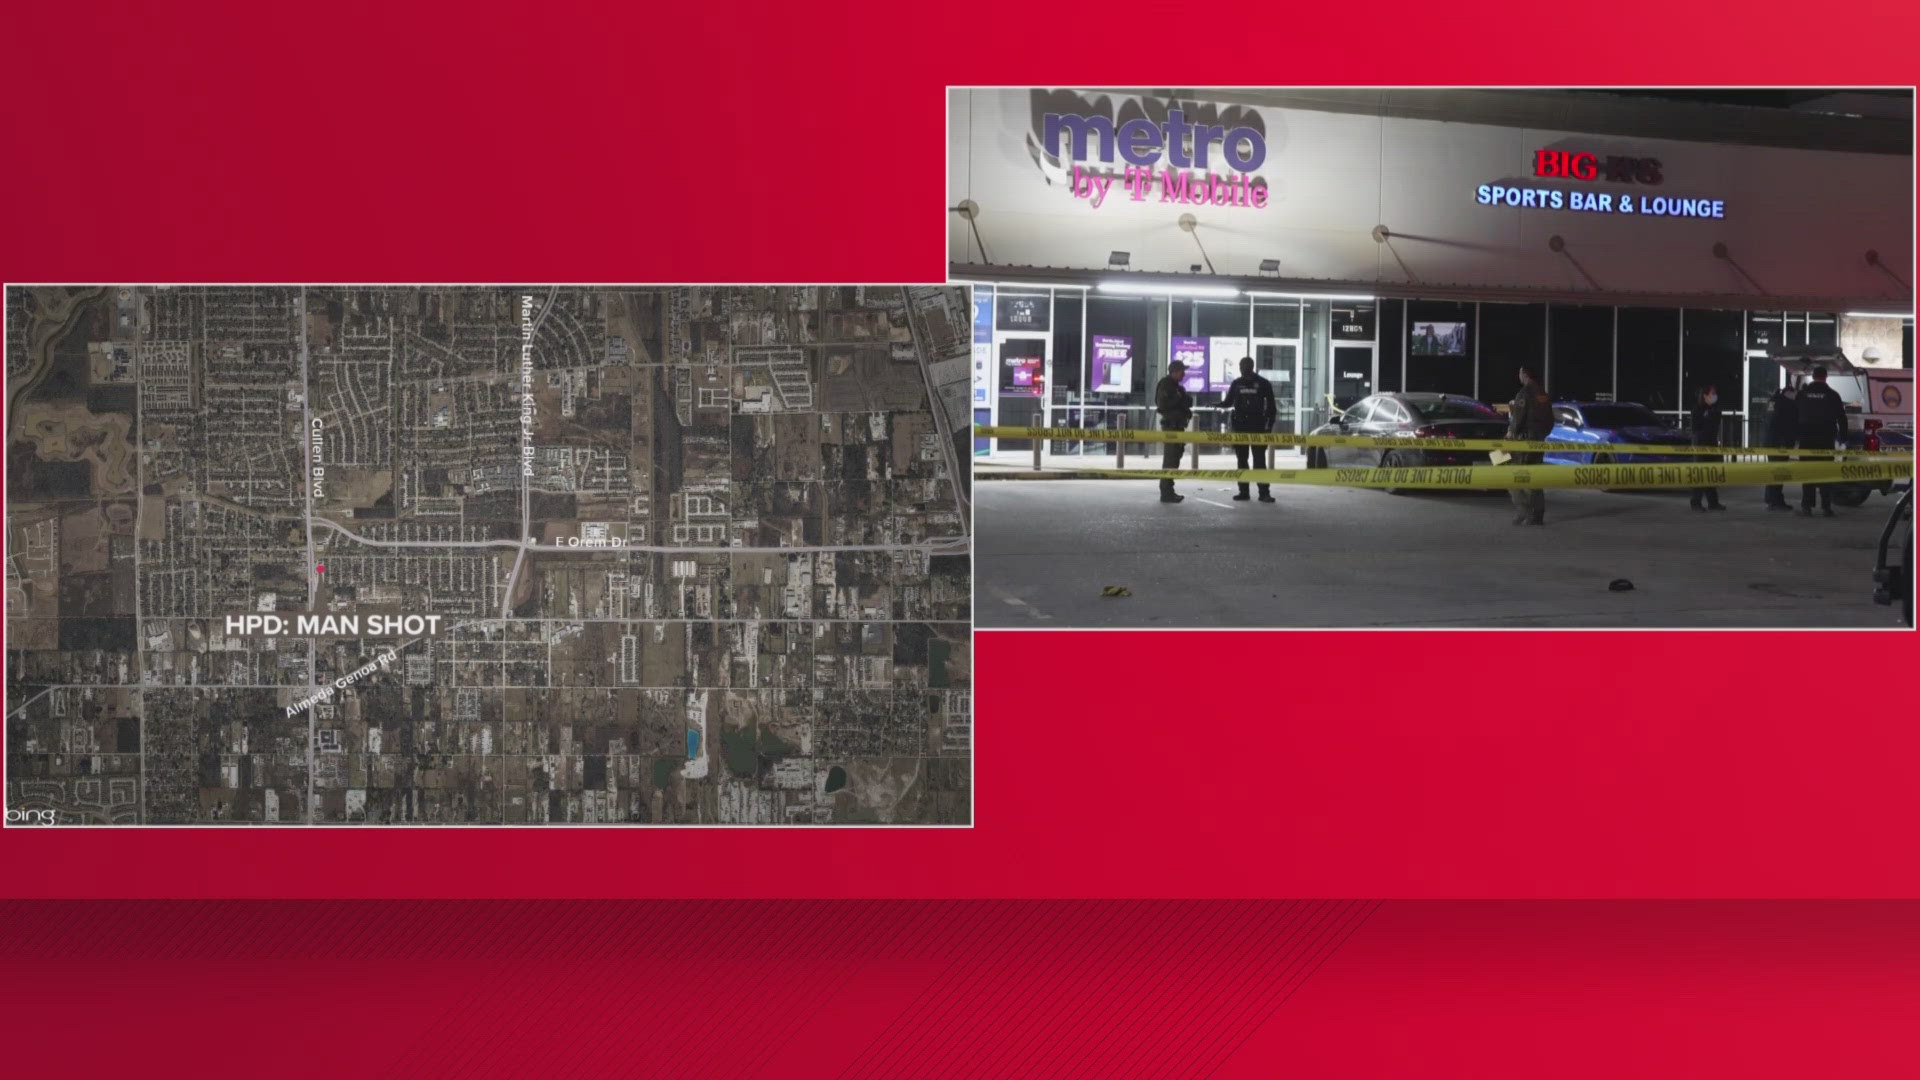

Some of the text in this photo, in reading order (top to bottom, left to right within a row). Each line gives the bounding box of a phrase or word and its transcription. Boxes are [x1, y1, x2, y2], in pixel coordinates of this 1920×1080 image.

[1043, 109, 1267, 173] metro
[1534, 150, 1597, 181] BIG
[1073, 165, 1268, 209] by T Mobile
[1477, 184, 1724, 218] SPORTS BAR & LOUNGE
[1174, 350, 1205, 369] $25
[1335, 468, 1473, 485] POLICE LINE DO NOT CROSS
[1574, 466, 1726, 485] POLICE LINE DO NOT CROSS
[1840, 464, 1911, 479] NOT CROSS
